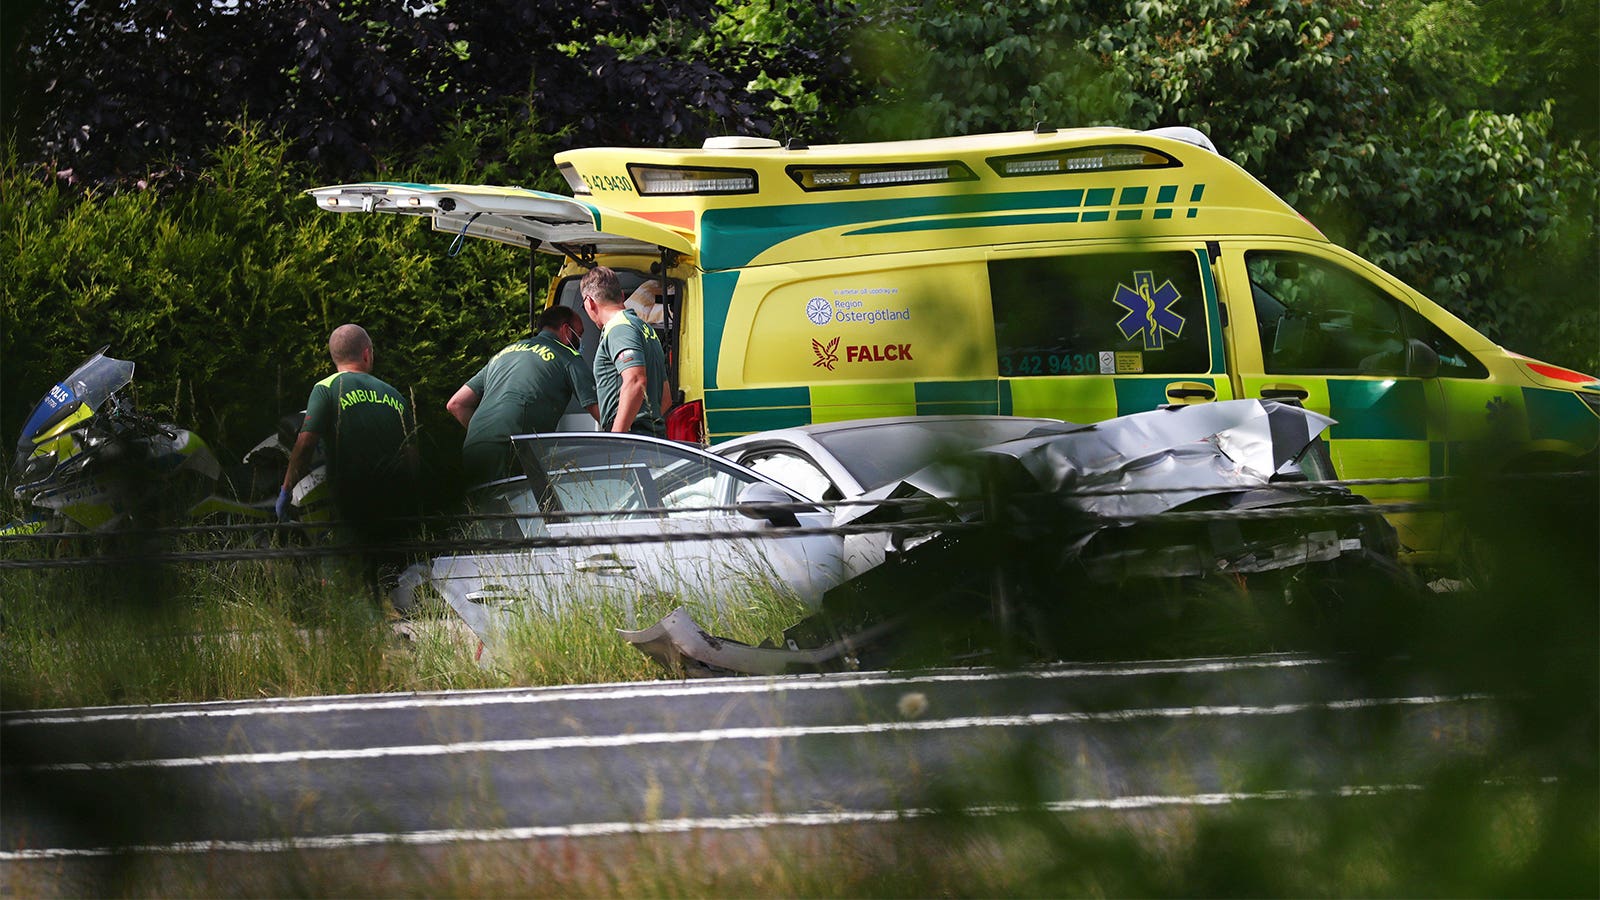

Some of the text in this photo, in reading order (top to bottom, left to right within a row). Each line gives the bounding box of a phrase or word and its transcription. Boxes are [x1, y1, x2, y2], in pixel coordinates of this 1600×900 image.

[582, 174, 633, 191] 3 42 9430
[834, 300, 863, 310] Region
[835, 308, 910, 325] Östergötland
[846, 344, 913, 362] FALCK
[1001, 356, 1013, 375] 3
[1019, 355, 1042, 375] 42
[1048, 353, 1097, 374] 9430
